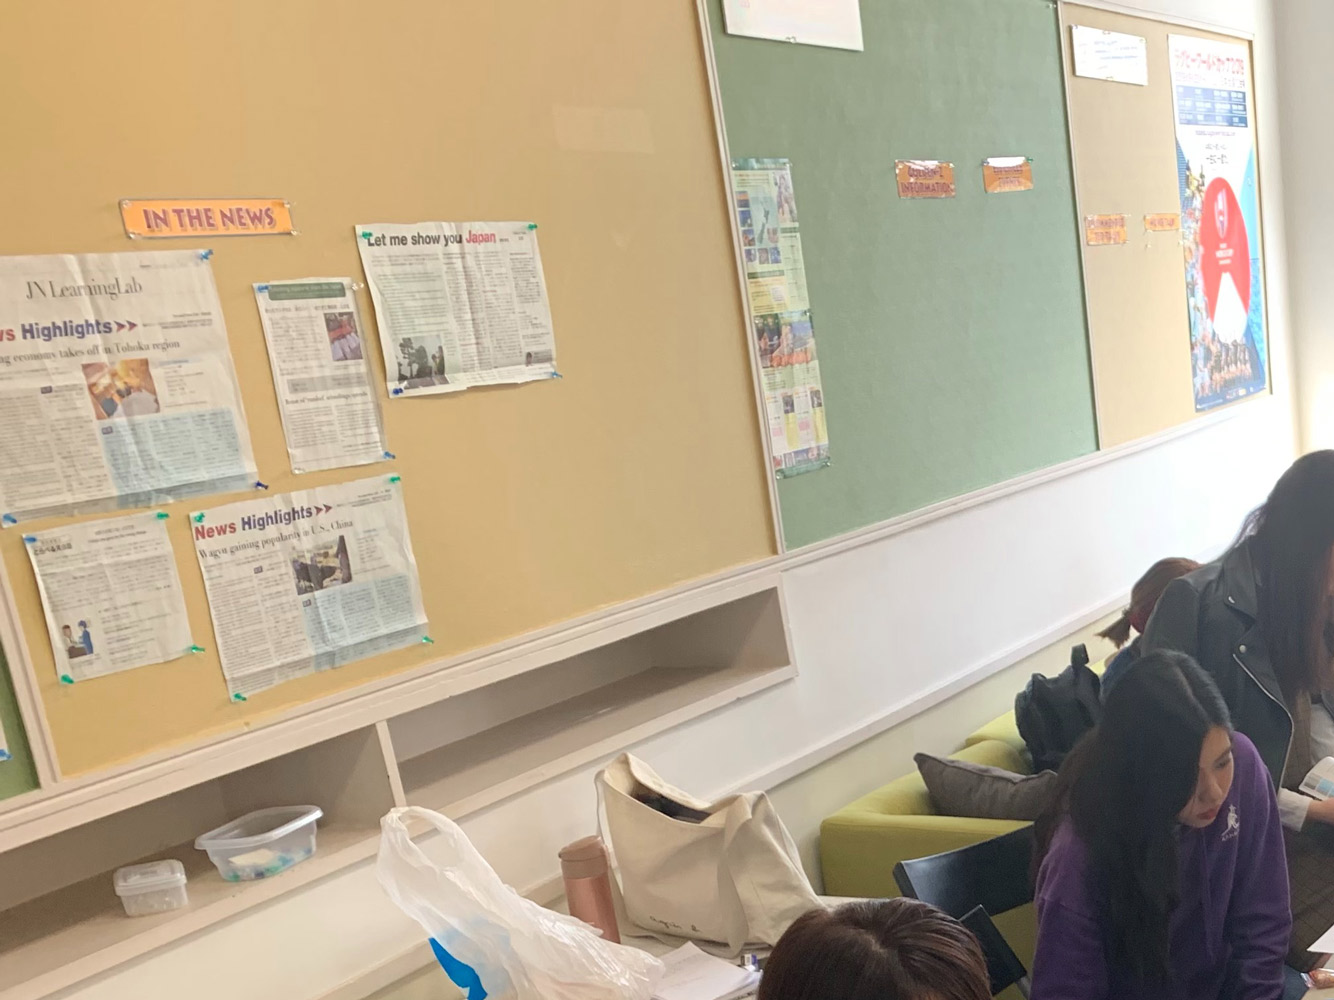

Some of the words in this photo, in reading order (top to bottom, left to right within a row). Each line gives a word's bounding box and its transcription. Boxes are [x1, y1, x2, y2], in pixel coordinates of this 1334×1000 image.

[142, 208, 170, 230] IN
[172, 207, 217, 230] THE
[219, 206, 277, 229] NEWS
[367, 233, 386, 247] Let
[390, 236, 408, 246] me
[411, 232, 441, 246] show
[444, 233, 463, 248] you
[466, 230, 497, 246] Japan
[21, 318, 114, 342] Highlights
[60, 346, 85, 358] takes
[152, 340, 181, 352] region
[194, 522, 237, 540] News
[241, 506, 313, 530] Highlights
[230, 540, 260, 555] gaining
[261, 531, 301, 548] popularity
[331, 519, 354, 531] China
